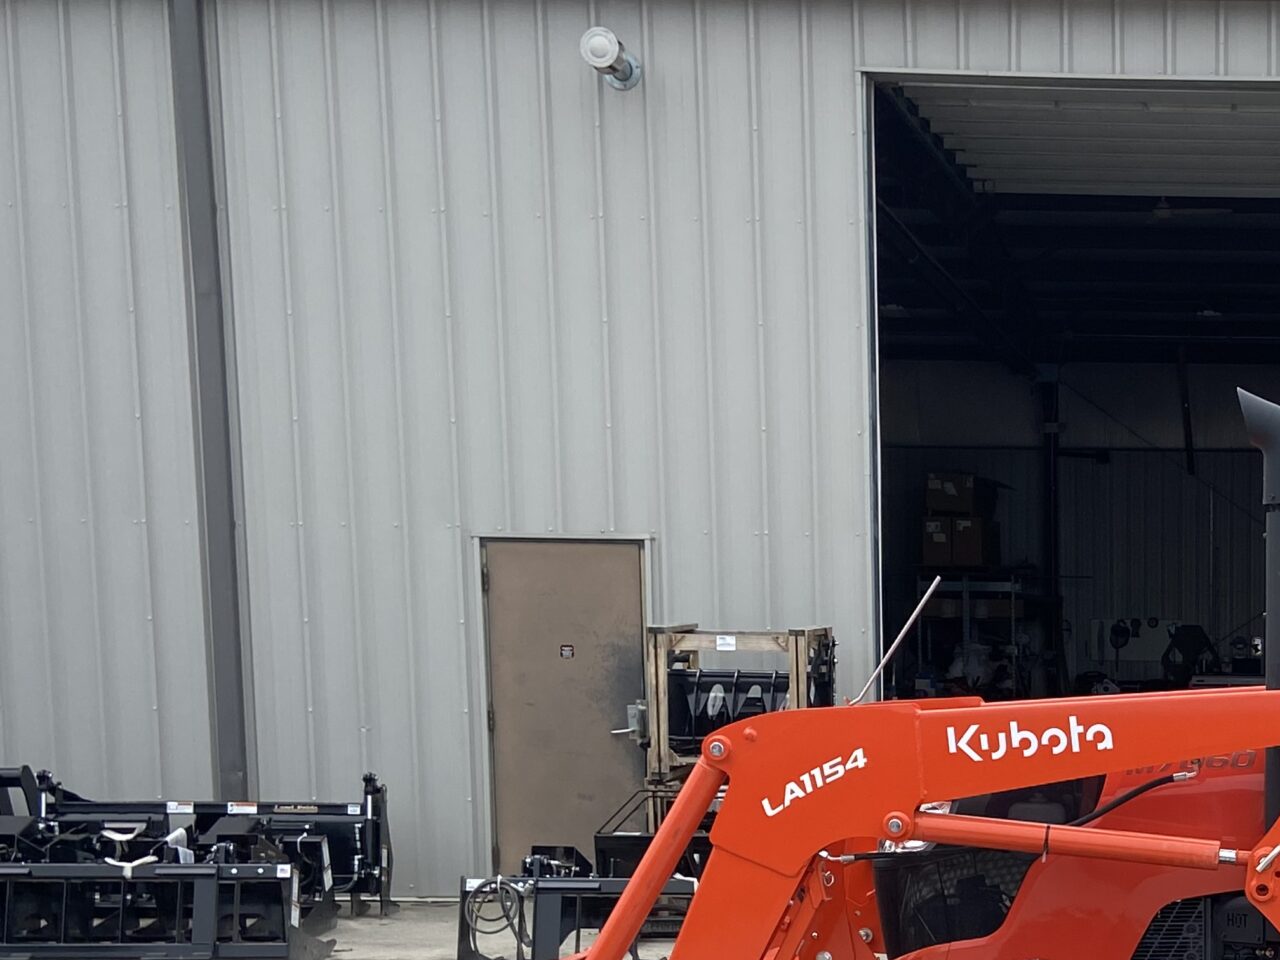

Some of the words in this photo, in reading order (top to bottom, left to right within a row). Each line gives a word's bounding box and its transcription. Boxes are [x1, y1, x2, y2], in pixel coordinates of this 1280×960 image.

[946, 715, 1114, 762] Kubota
[761, 747, 868, 818] LA1154
[1226, 912, 1249, 928] HOT
